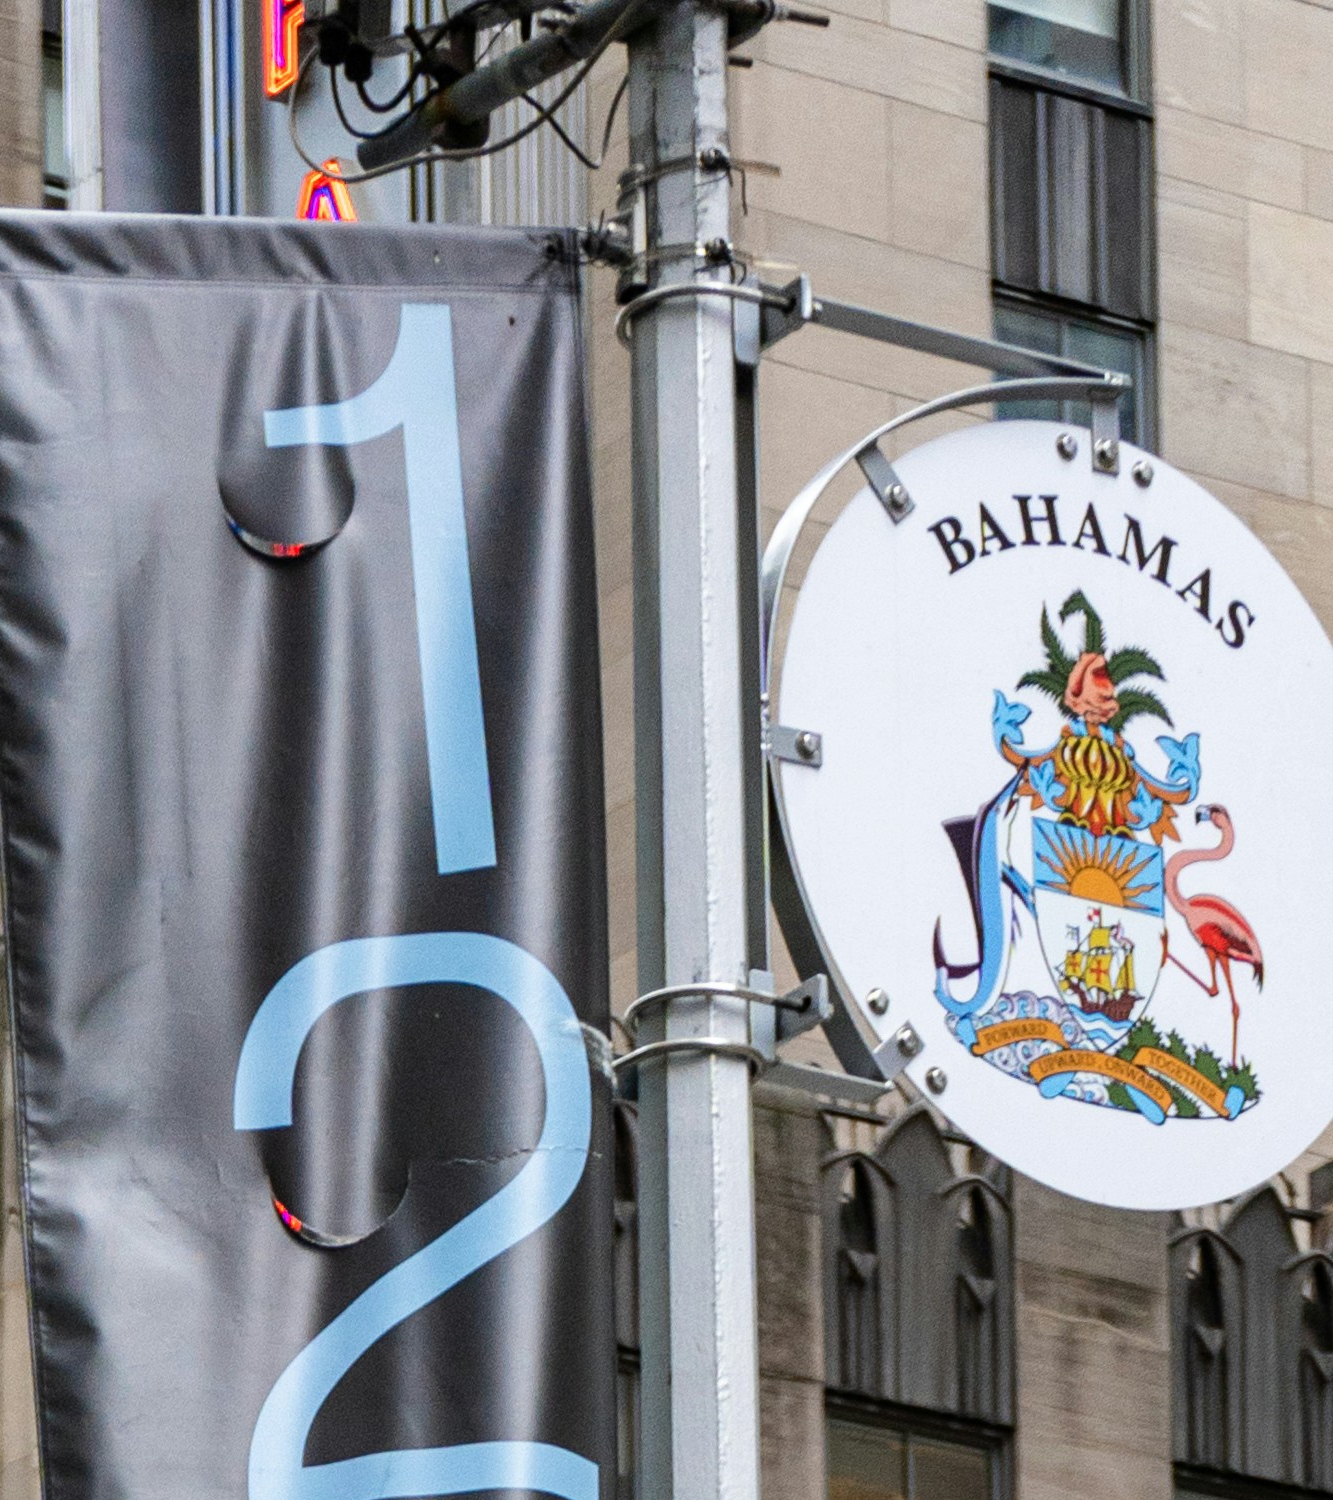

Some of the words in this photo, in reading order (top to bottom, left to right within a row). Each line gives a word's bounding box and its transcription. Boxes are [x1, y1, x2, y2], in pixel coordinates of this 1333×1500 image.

[928, 493, 1256, 650] BAHAMAS
[983, 1021, 1047, 1047] FORWARD
[1148, 1050, 1217, 1099] TOGETHER
